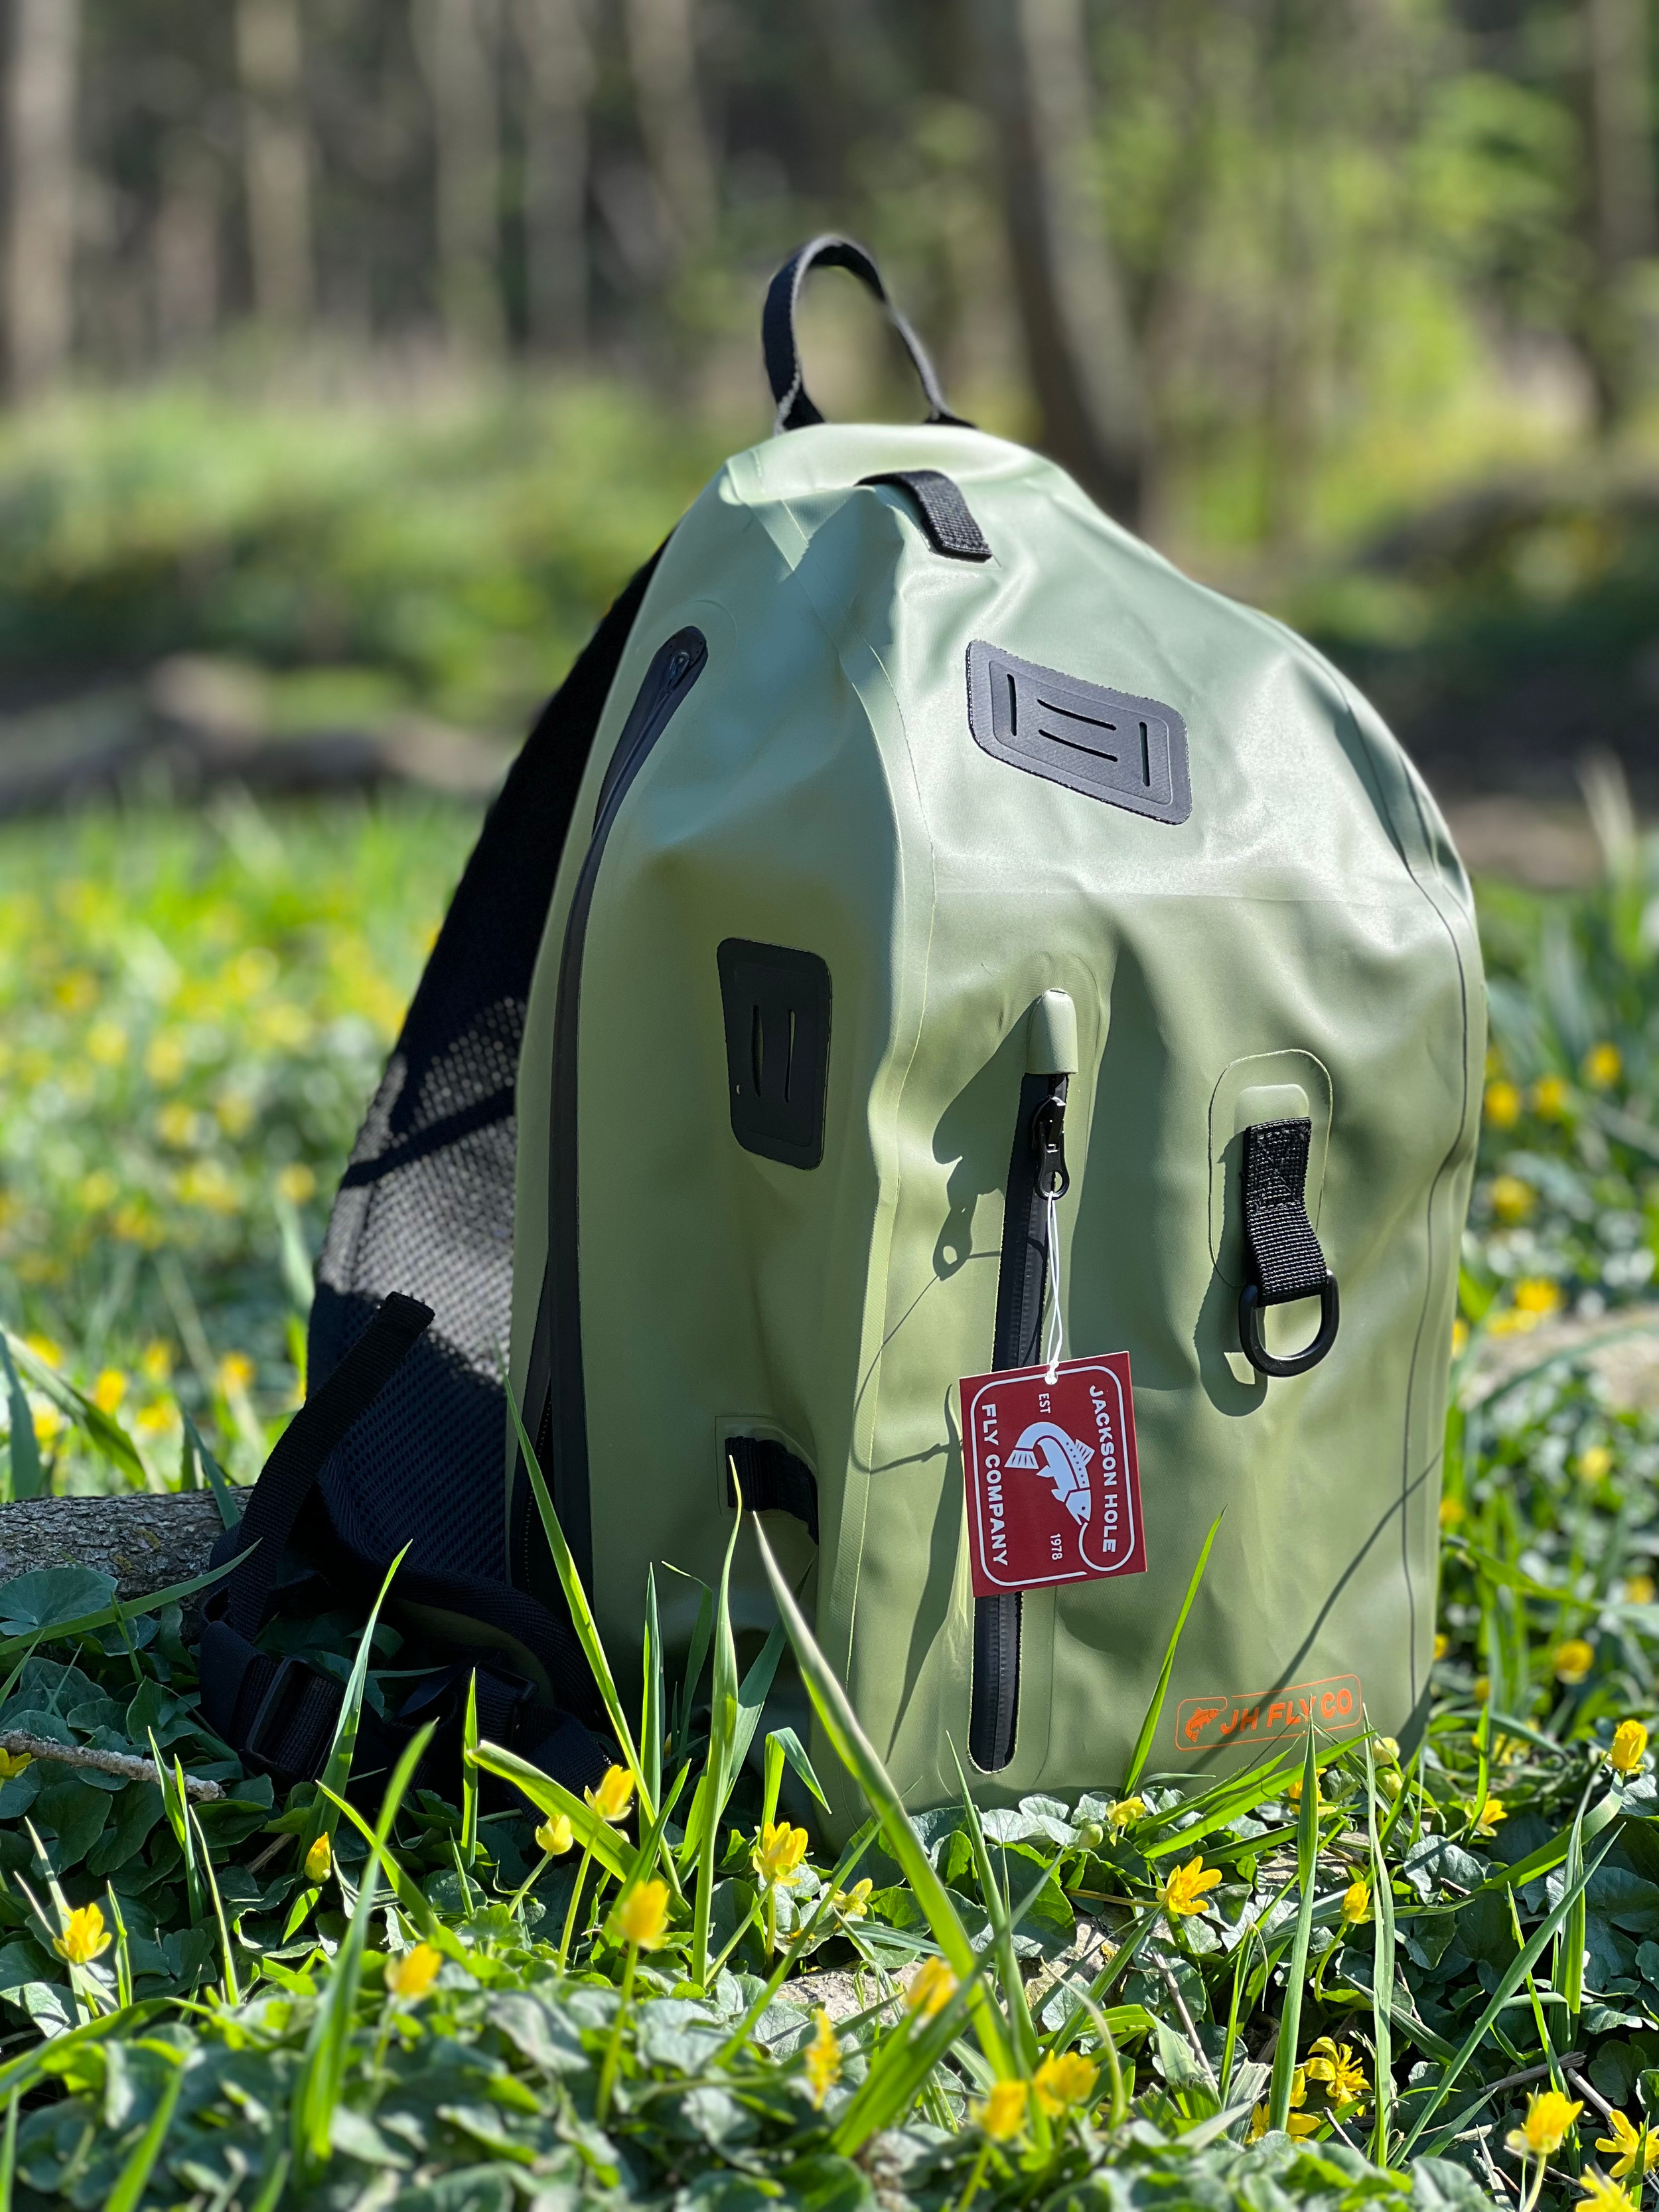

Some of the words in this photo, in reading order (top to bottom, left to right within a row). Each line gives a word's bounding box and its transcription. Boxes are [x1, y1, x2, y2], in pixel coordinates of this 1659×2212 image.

[981, 1403, 999, 1445] FLY
[1038, 1392, 1051, 1414] EST
[1089, 1384, 1117, 1486] JACKSON
[985, 1453, 1009, 1566] COMPANY
[1102, 1494, 1118, 1553] HOLE
[1050, 1532, 1063, 1560] 1978
[1220, 1706, 1260, 1735] JH
[1265, 1695, 1317, 1728] FLY
[1321, 1688, 1352, 1720] CO
